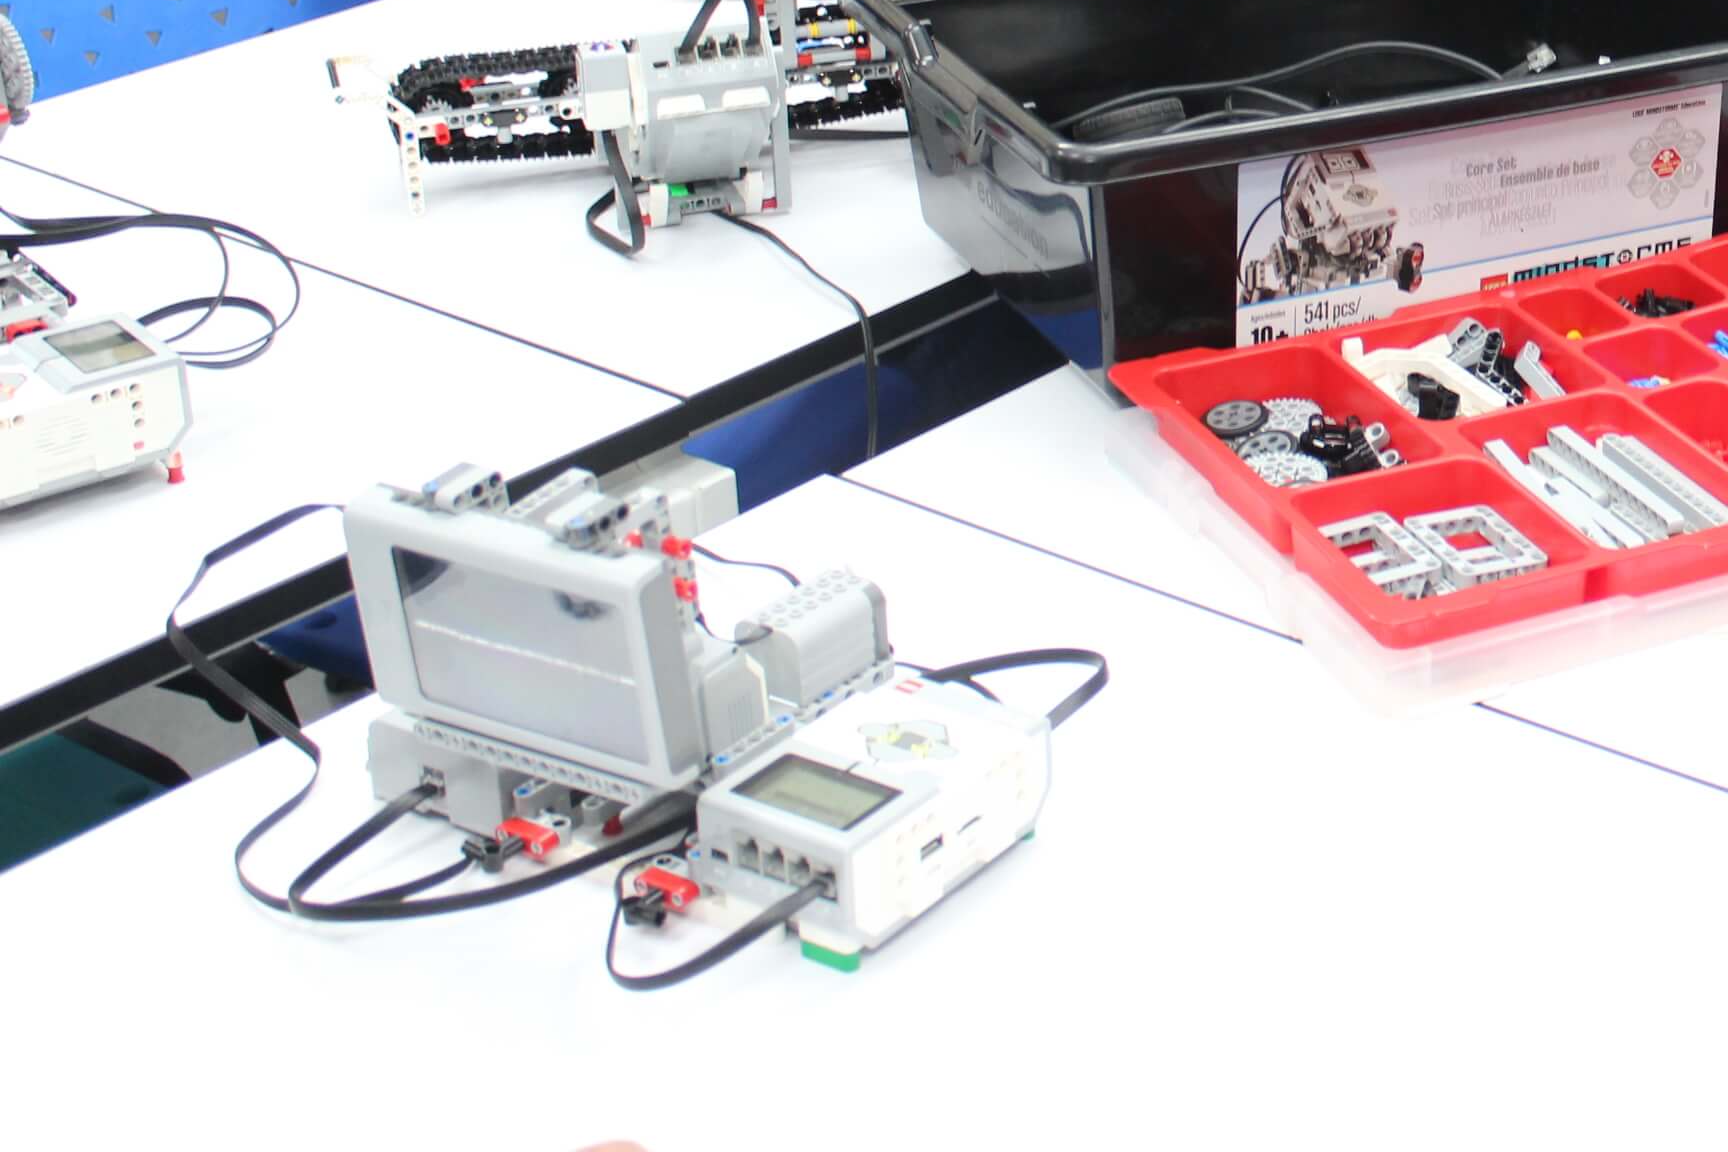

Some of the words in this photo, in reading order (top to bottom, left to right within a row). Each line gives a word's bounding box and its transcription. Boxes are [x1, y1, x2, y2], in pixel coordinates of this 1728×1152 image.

[1465, 161, 1494, 178] Core
[1497, 157, 1517, 173] Set
[1304, 301, 1329, 325] 541
